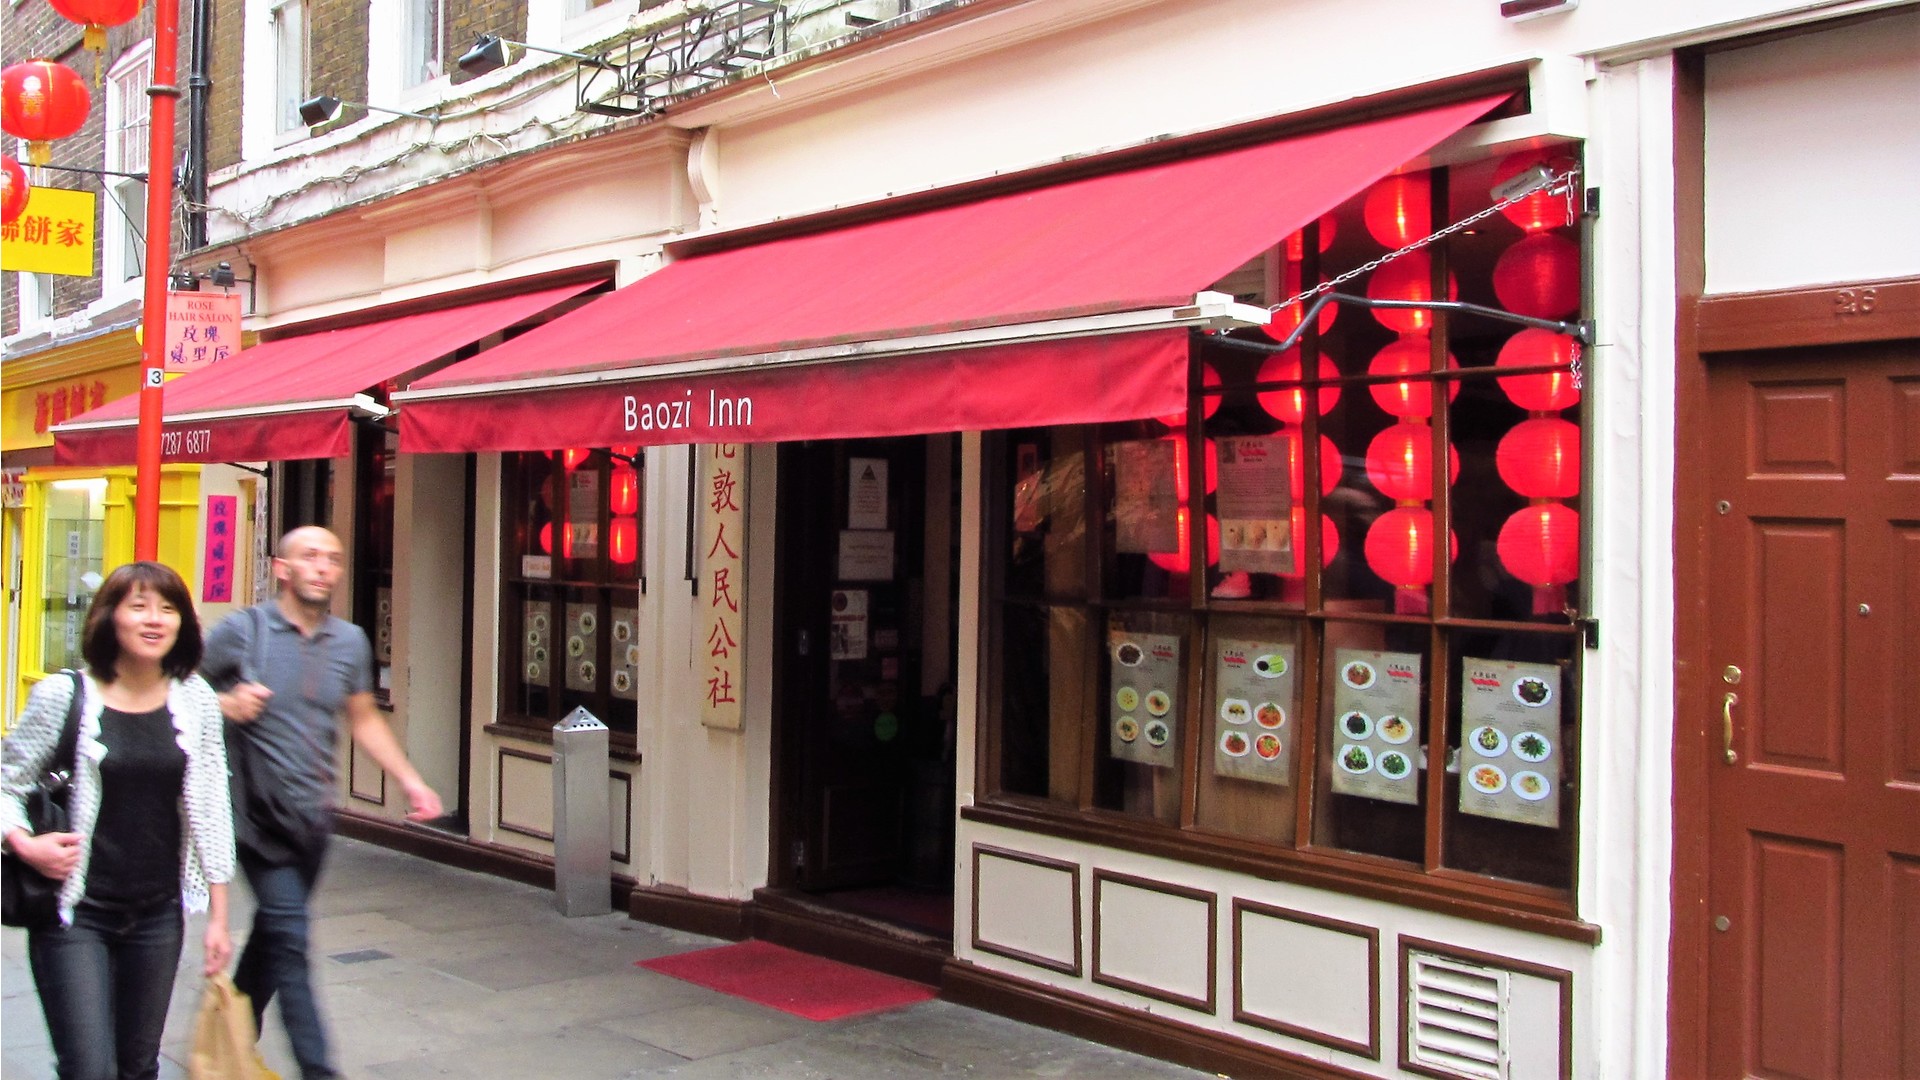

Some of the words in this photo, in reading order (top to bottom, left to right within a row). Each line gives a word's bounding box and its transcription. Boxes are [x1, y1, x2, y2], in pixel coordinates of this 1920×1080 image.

[187, 301, 214, 311] ROSE
[169, 312, 196, 321] HAIR
[199, 313, 233, 323] SALON
[152, 370, 161, 385] 3
[624, 389, 692, 431] Baozi
[708, 389, 752, 427] Inn
[186, 429, 210, 454] 6877
